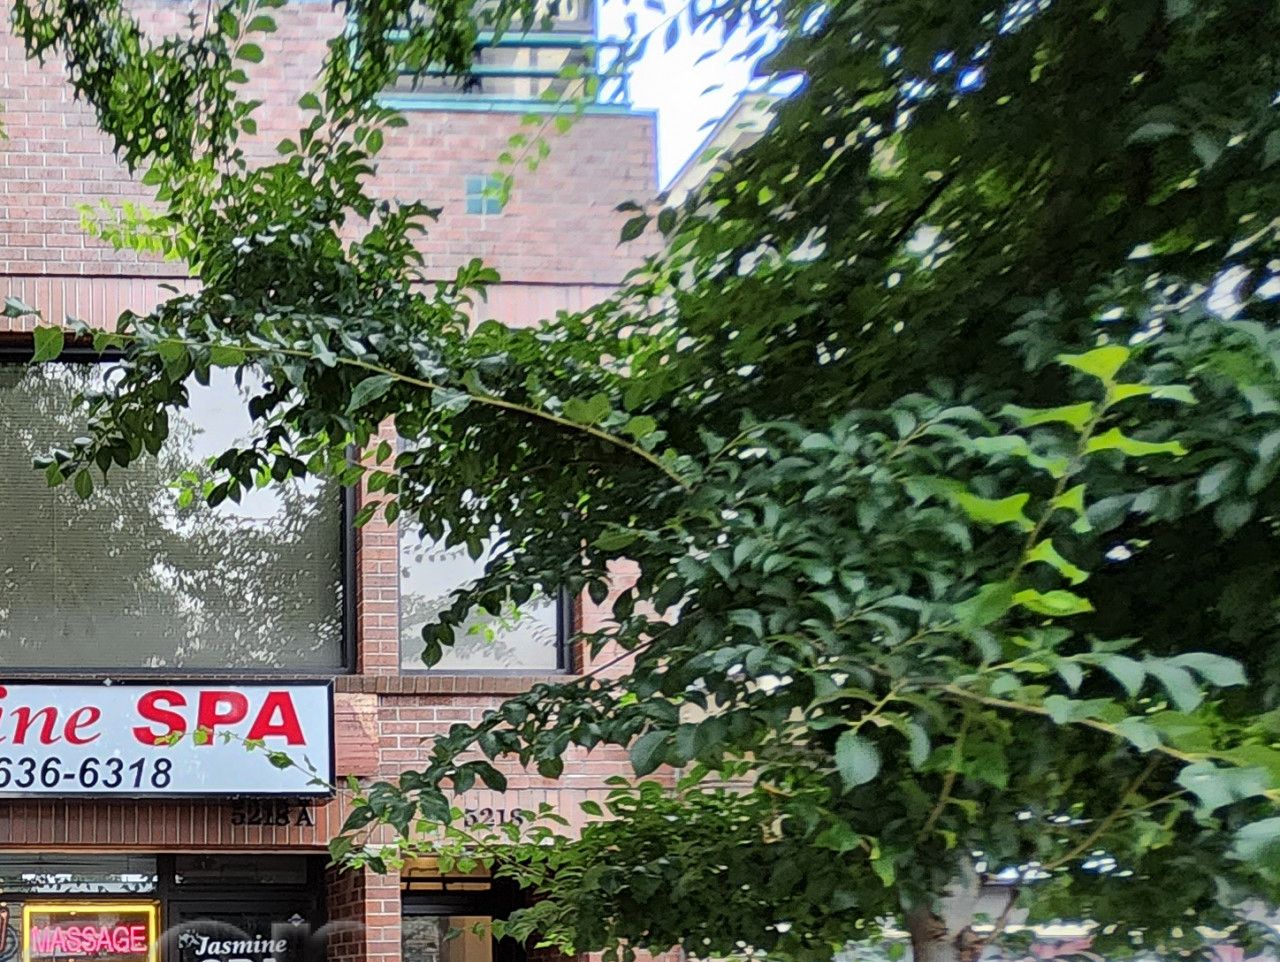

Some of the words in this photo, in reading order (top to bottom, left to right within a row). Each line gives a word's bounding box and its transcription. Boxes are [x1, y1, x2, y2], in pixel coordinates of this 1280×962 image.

[132, 689, 308, 747] SPA
[31, 926, 147, 954] MASSAGE
[195, 934, 288, 956] Jasmine
